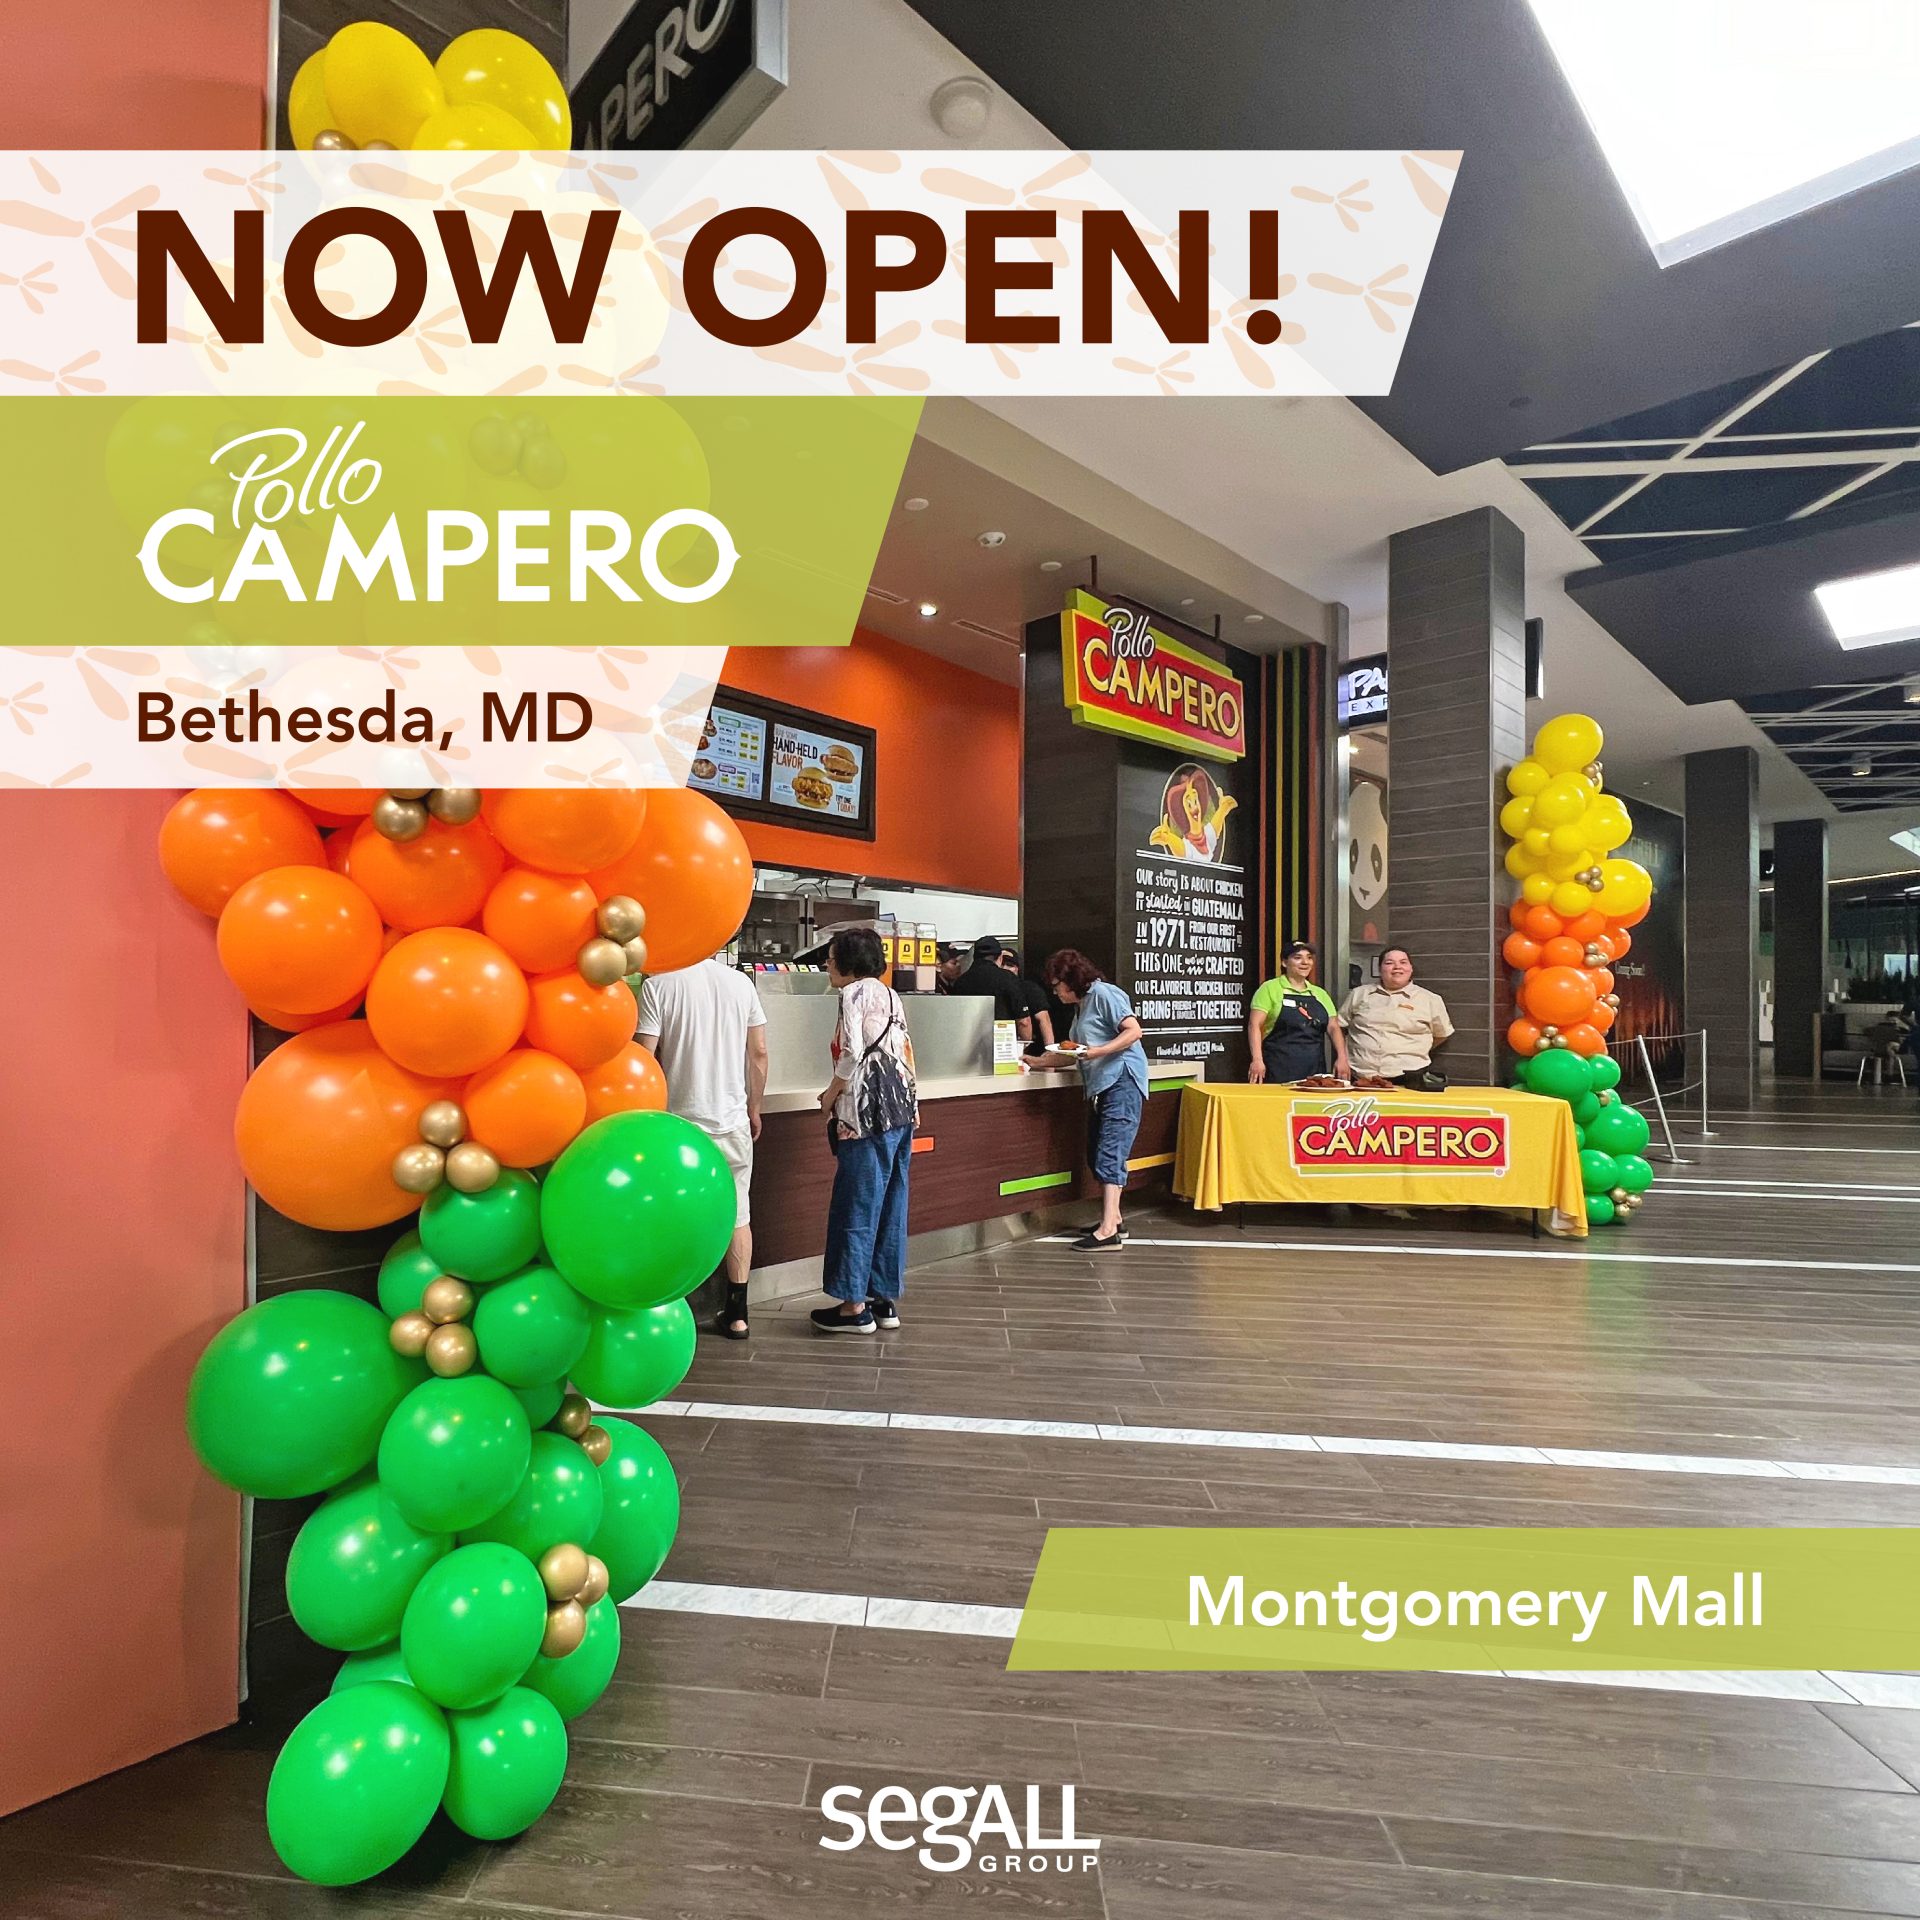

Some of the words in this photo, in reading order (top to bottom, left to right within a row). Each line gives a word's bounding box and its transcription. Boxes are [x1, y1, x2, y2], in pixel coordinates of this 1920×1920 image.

[1104, 607, 1155, 657] Pollo
[1083, 638, 1240, 737] CAMPERO
[773, 750, 804, 770] FLAVOR
[1136, 868, 1153, 885] OUR
[1155, 871, 1178, 894] story
[1180, 874, 1189, 890] IS
[1191, 876, 1214, 893] ABOUT
[1145, 892, 1183, 911] started
[1192, 898, 1243, 920] GUATEMALA
[1136, 921, 1148, 938] IN
[1190, 935, 1236, 953] RESTAURANT
[1134, 952, 1160, 972] THIS
[1205, 956, 1244, 975] CRAFTED
[1135, 981, 1149, 994] OUR
[1150, 980, 1193, 995] FLAVORFUL
[1194, 981, 1223, 995] CHICKEN
[1142, 1001, 1171, 1019] BRING
[1183, 1041, 1210, 1056] CHICKEN
[1323, 1098, 1379, 1132] Pollo
[1298, 1124, 1501, 1159] CAMPERO
